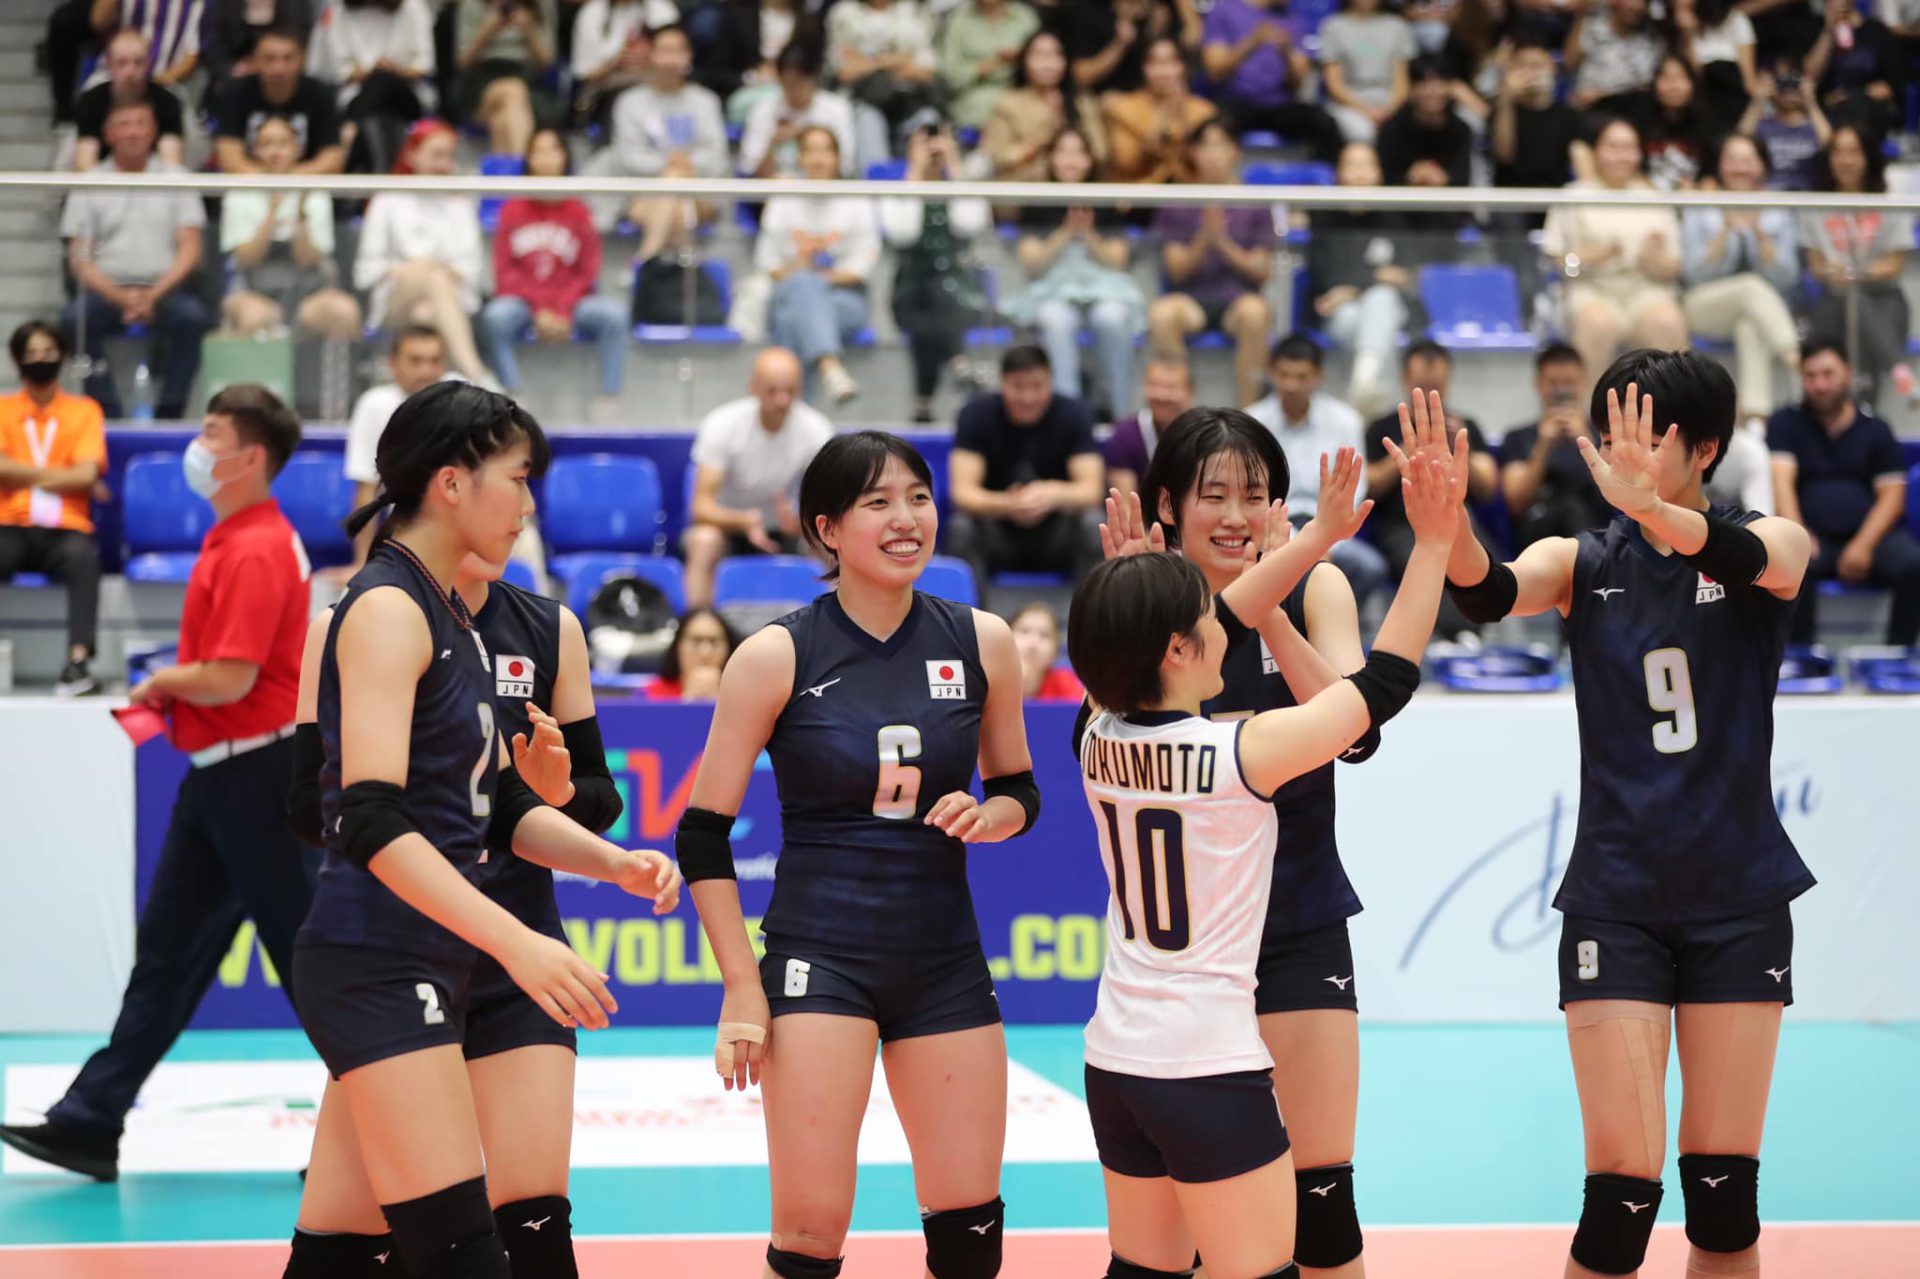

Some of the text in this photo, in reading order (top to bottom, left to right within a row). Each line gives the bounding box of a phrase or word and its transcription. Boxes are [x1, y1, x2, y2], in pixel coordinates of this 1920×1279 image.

[1698, 586, 1722, 602] JPN
[502, 684, 529, 695] JPN
[937, 687, 961, 697] JPN
[1643, 647, 1698, 754] 9
[469, 702, 495, 816] 2
[872, 725, 922, 820] 6
[1098, 799, 1192, 953] 10
[784, 958, 811, 997] 6
[1577, 940, 1599, 980] 9
[415, 982, 445, 1025] 2
